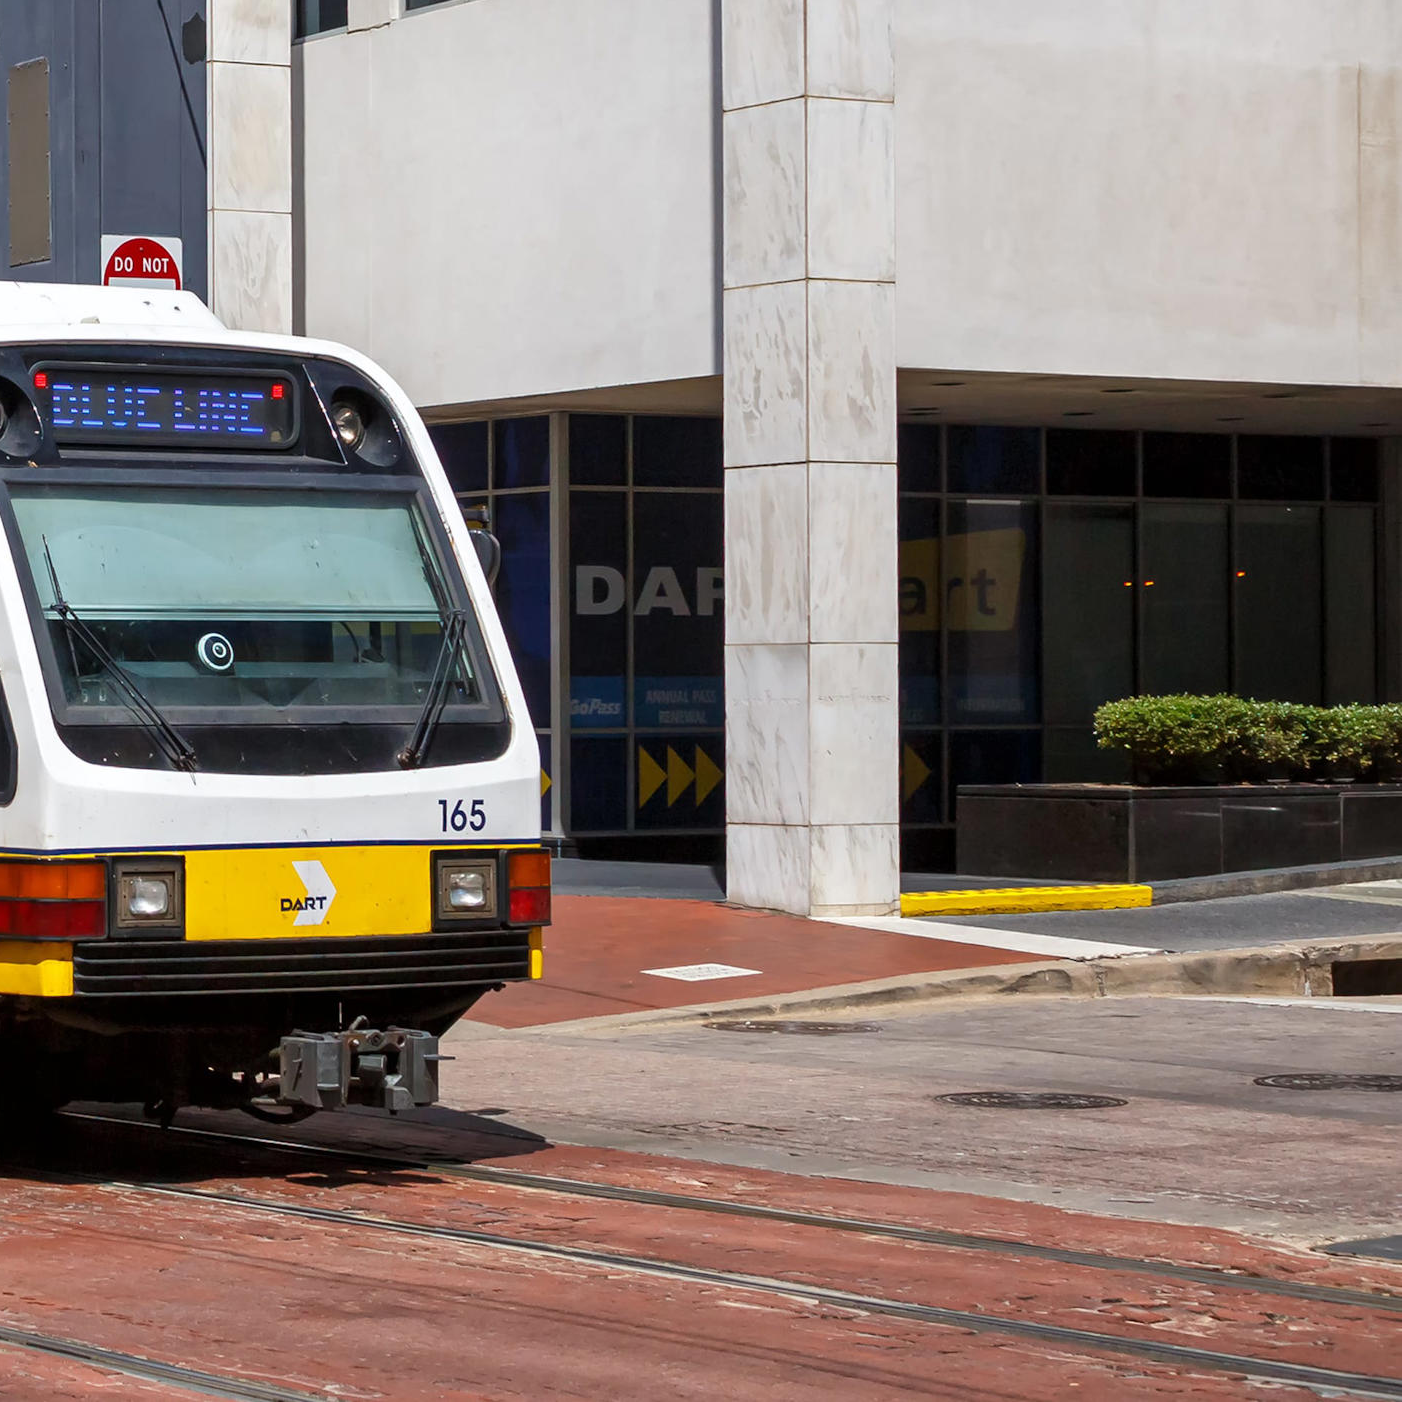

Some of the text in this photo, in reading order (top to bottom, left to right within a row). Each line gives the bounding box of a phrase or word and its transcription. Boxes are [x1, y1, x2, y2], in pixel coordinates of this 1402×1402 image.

[114, 256, 169, 273] DO NOT
[52, 384, 263, 432] BLUE LINE
[570, 698, 622, 715] GoPass
[438, 799, 486, 832] 165
[280, 896, 327, 912] DART
